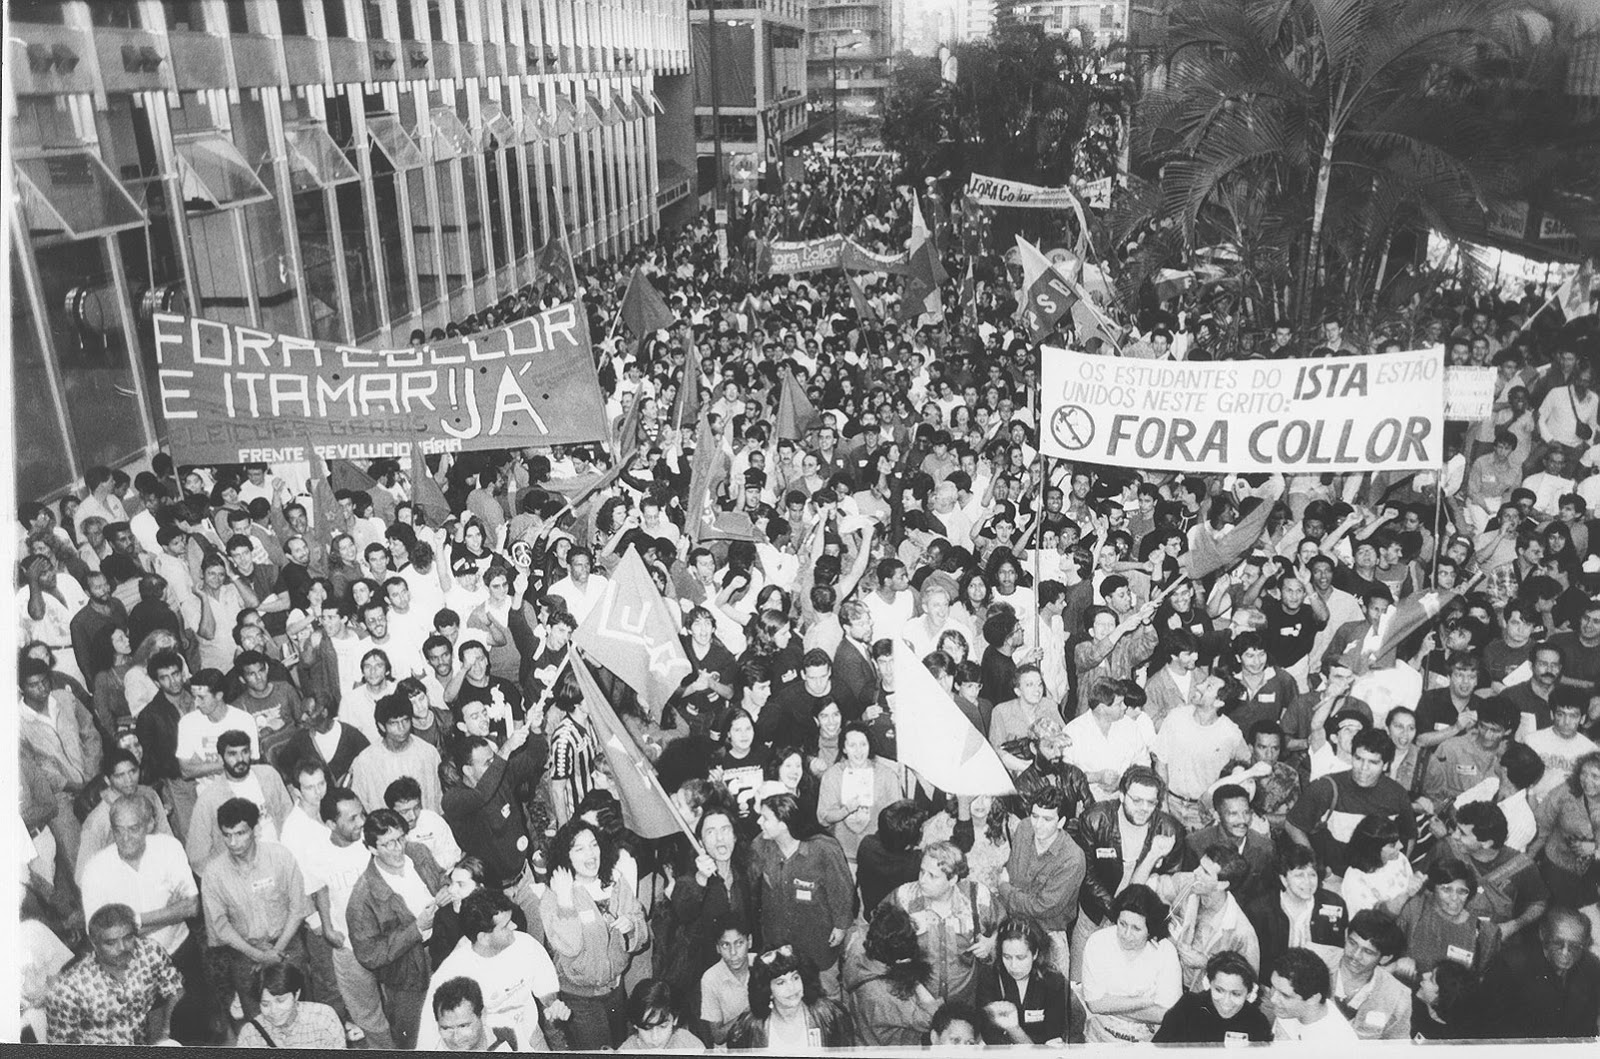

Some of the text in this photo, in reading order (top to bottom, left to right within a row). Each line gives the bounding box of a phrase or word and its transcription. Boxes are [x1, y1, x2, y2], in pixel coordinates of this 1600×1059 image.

[153, 303, 579, 367] FORA COLLOR
[159, 369, 198, 419] E
[441, 361, 549, 439] JÁ
[1062, 380, 1136, 408] UNIDOS
[1143, 387, 1208, 412] NESTE
[1079, 361, 1106, 382] OS
[1115, 366, 1238, 389] ESTUDANTES
[1252, 368, 1282, 389] DO
[1293, 362, 1368, 400] ISTA
[238, 437, 462, 463] FRENTE REVOLUCIOÁRIA
[1106, 414, 1432, 464] FORA COLLOR
